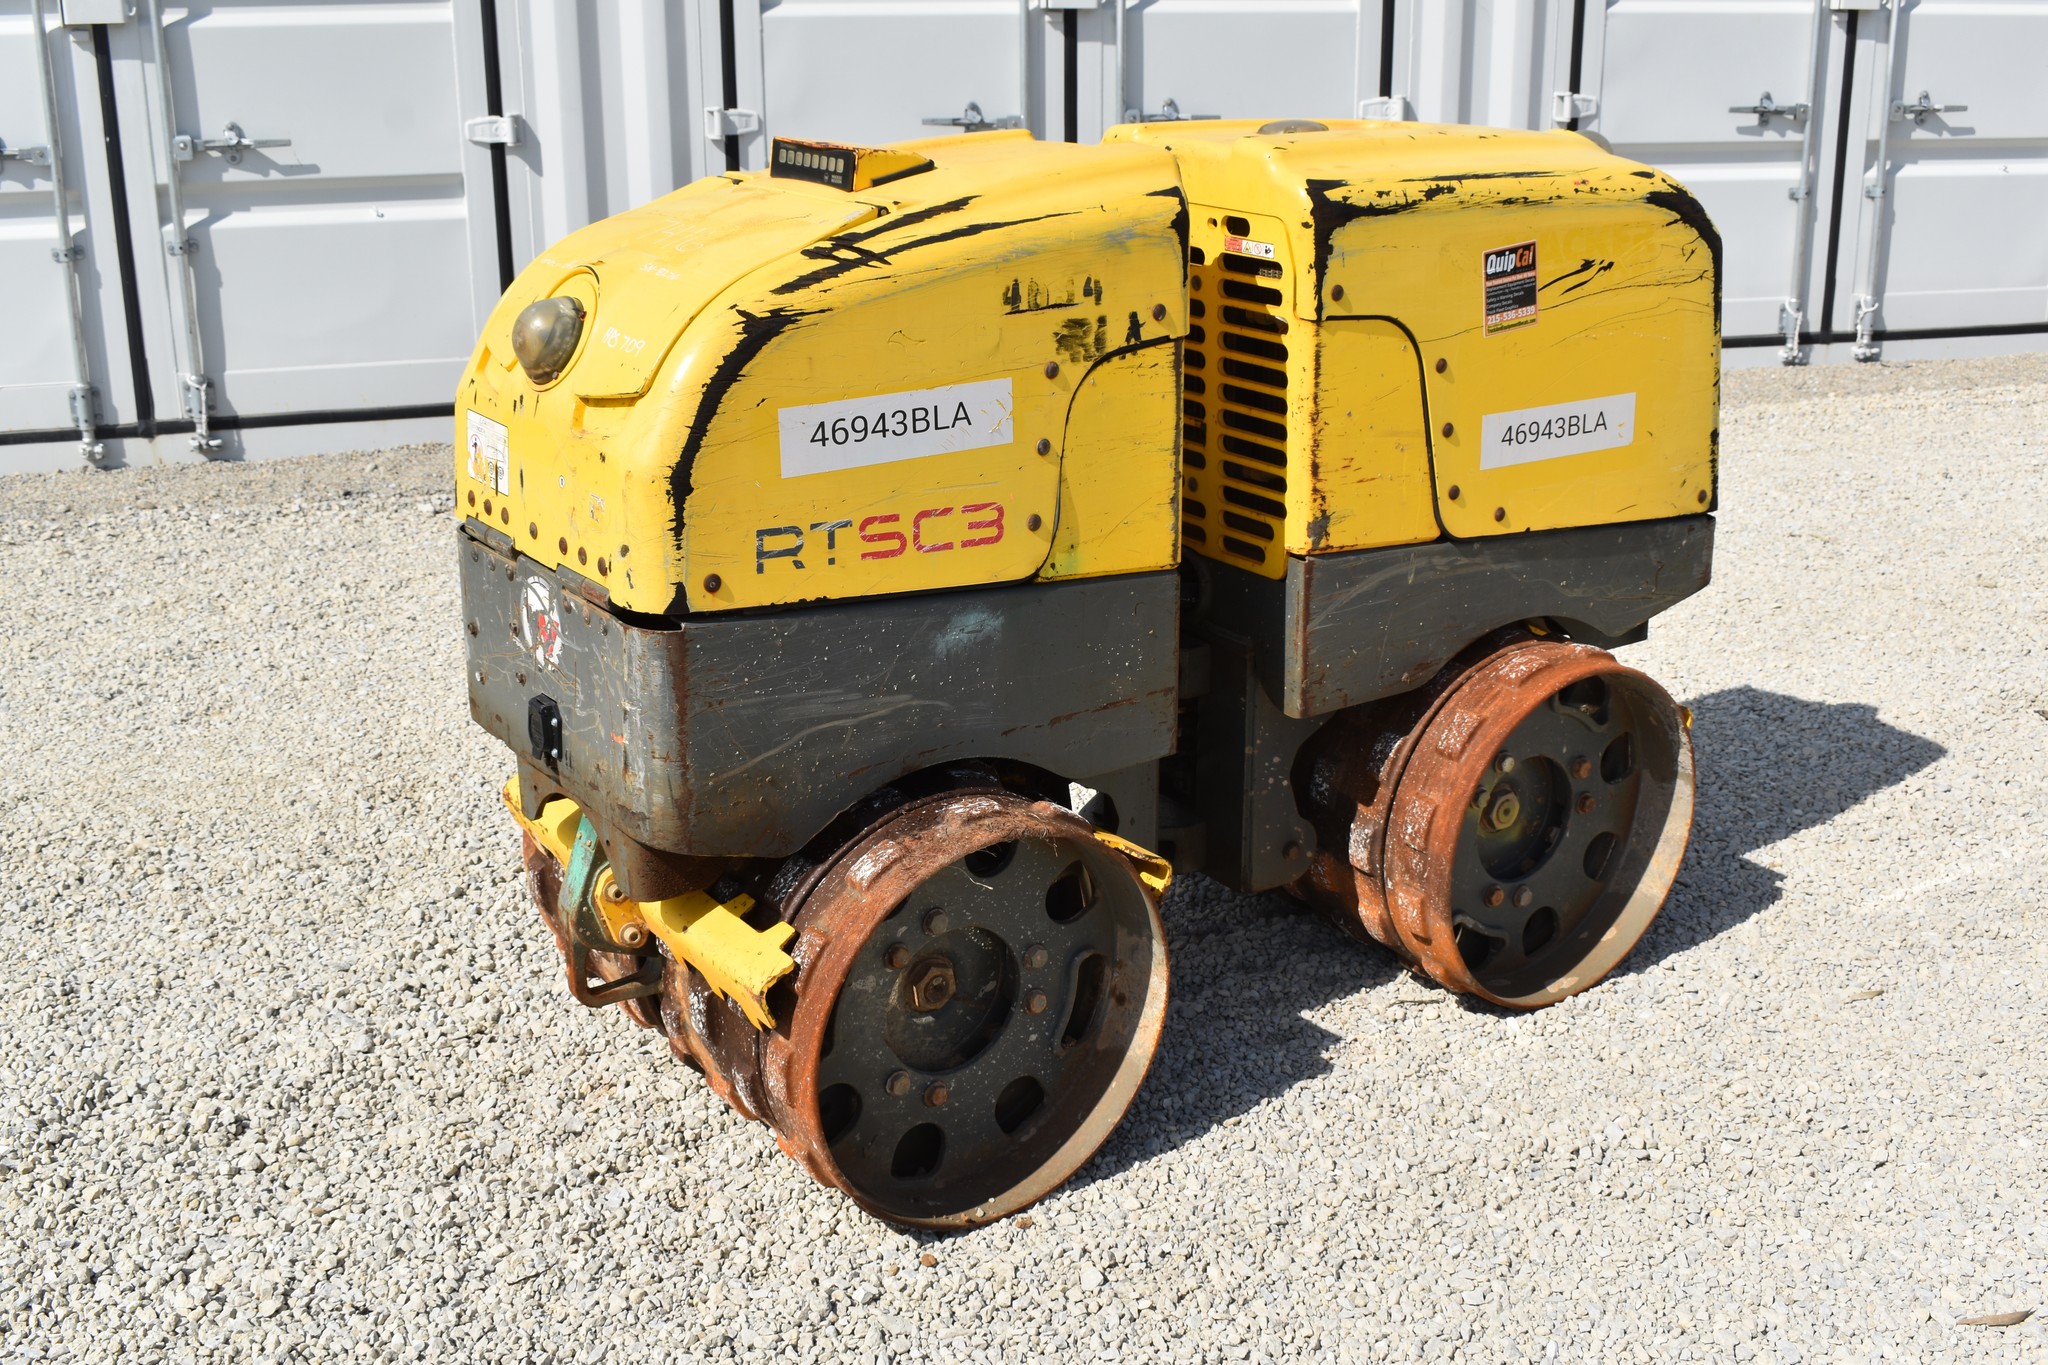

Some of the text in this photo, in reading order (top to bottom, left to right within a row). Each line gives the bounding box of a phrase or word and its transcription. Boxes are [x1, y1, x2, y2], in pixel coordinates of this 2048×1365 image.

[1486, 245, 1535, 275] QuipCal
[1487, 305, 1535, 325] 215-536-5339
[620, 335, 646, 356] 709
[809, 401, 973, 447] 46943BLA
[1501, 410, 1608, 446] 46943BLA
